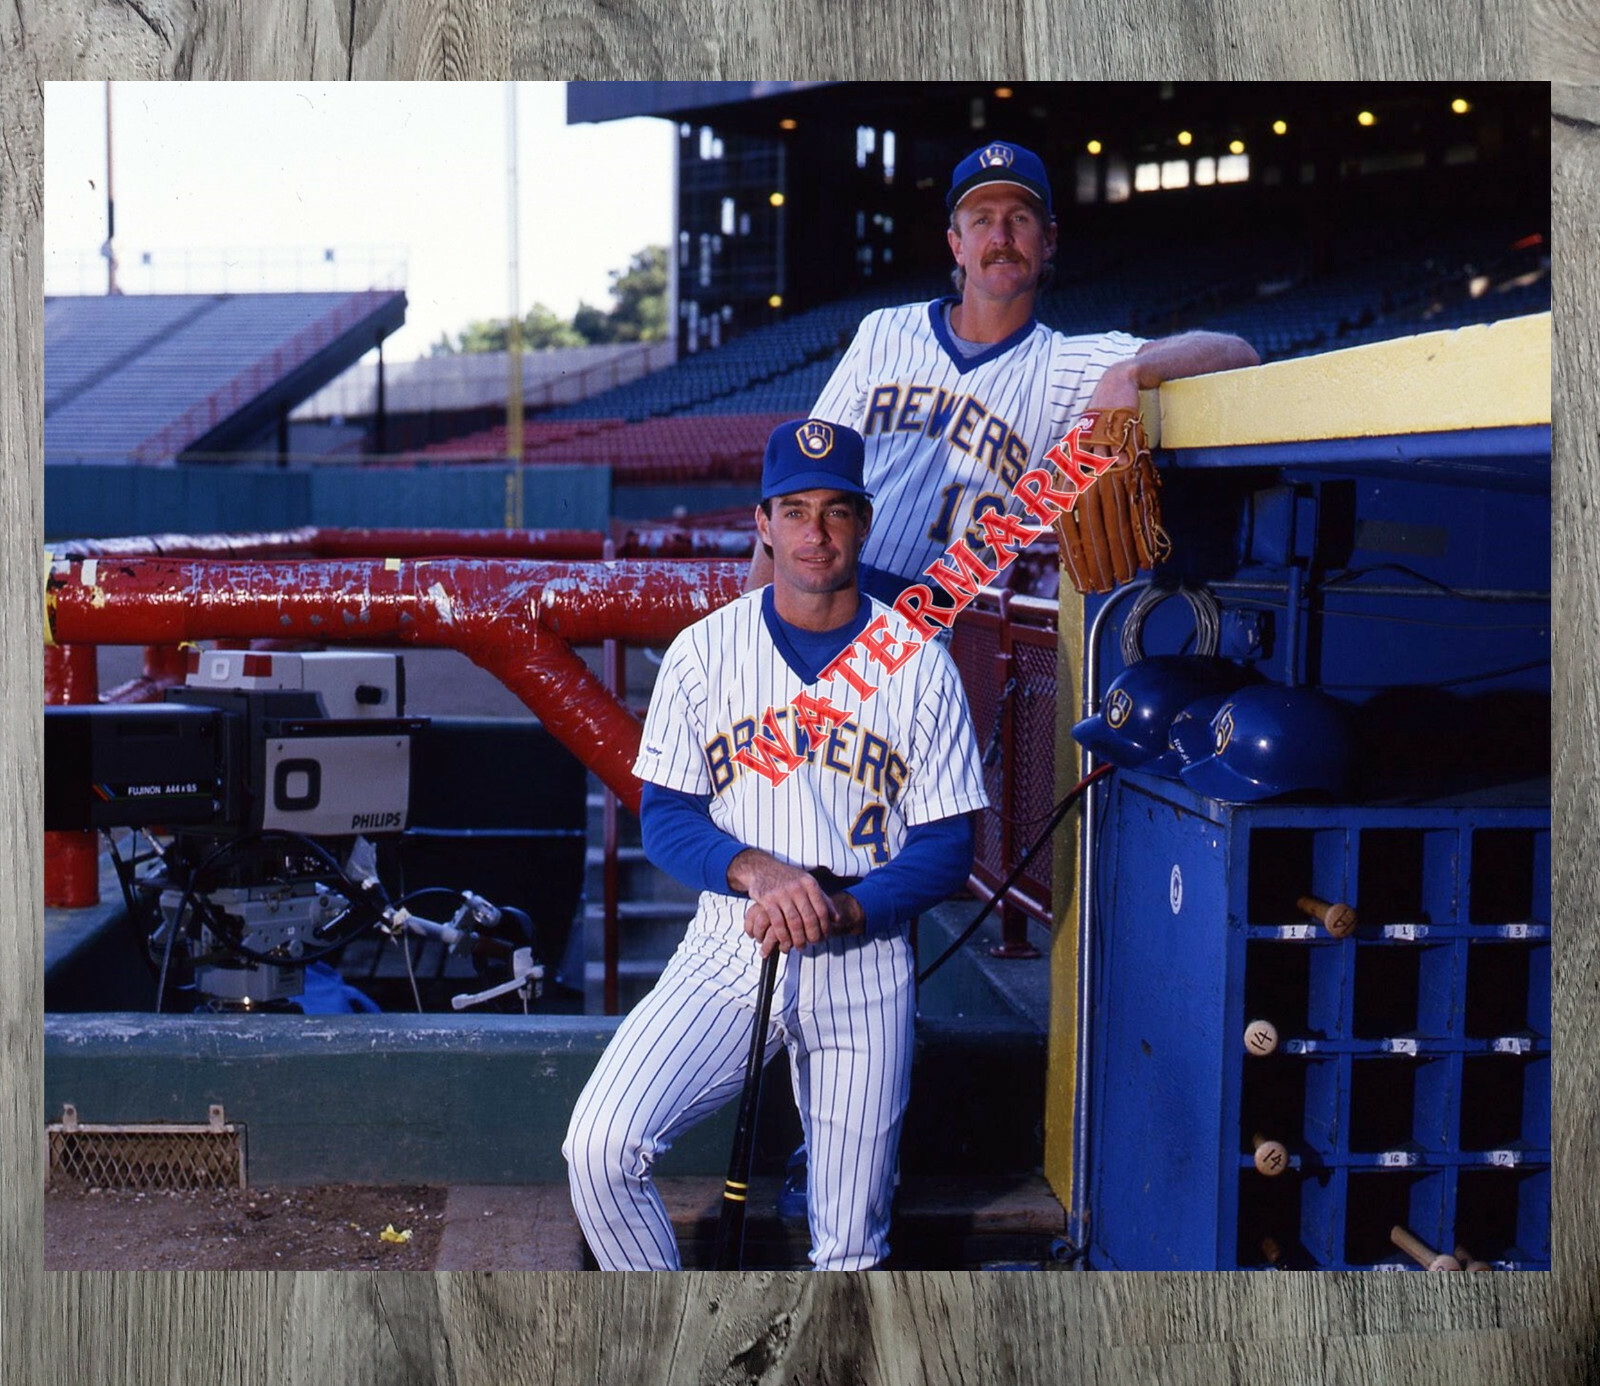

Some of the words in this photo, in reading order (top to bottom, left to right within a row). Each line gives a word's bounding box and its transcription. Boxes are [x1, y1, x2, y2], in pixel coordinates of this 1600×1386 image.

[127, 785, 161, 797] FUJINON
[351, 812, 401, 829] PHILIPS
[849, 802, 892, 866] 4
[1514, 926, 1522, 936] 3
[1250, 1030, 1273, 1051] 14
[1399, 1041, 1408, 1050] 7
[1263, 1149, 1282, 1170] 14
[1390, 1154, 1400, 1164] 16
[1498, 1153, 1508, 1162] 17
